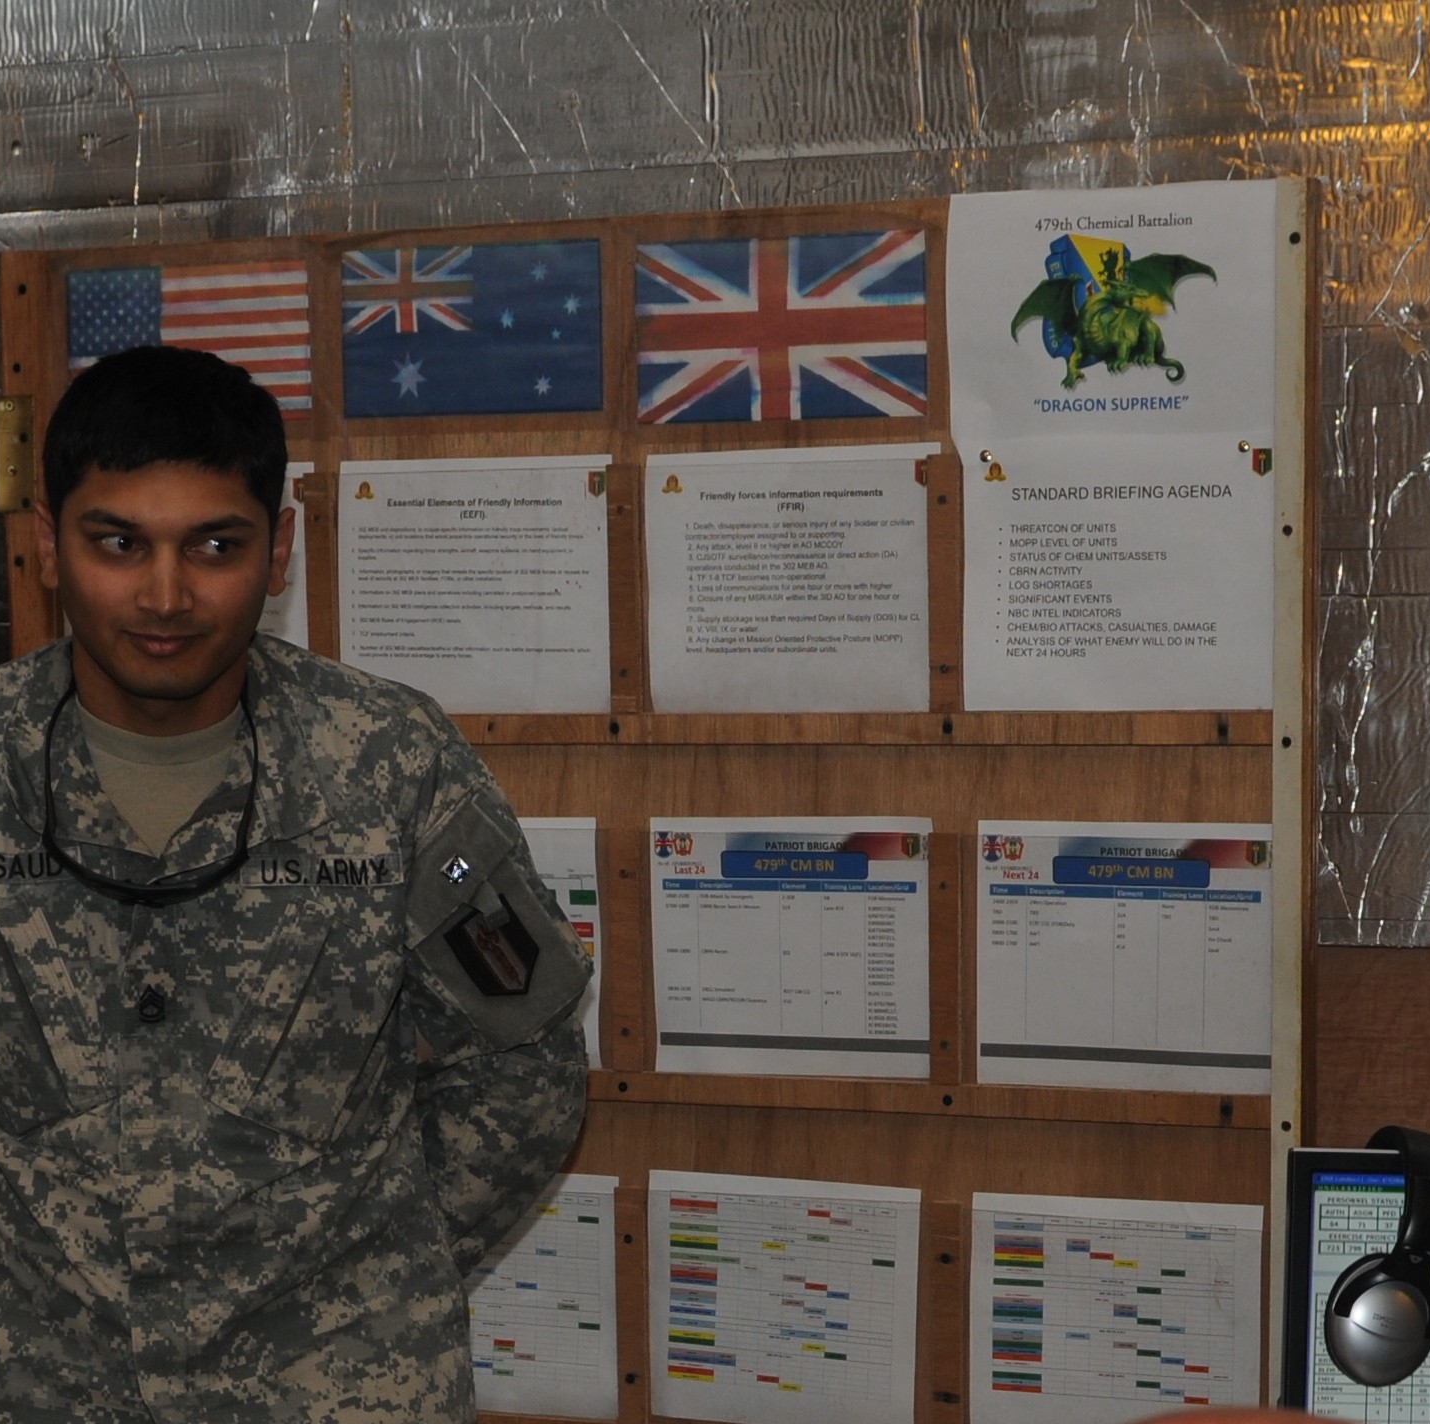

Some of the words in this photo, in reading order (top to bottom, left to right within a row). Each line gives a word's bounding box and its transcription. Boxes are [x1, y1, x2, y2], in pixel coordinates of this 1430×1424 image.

[1034, 218, 1072, 232] 479th
[1077, 215, 1134, 229] Chemical
[1138, 214, 1193, 228] Battalion
[700, 492, 736, 501] Friendly
[823, 488, 883, 499] requirements
[1011, 487, 1089, 501] STANDARD
[1093, 486, 1164, 500] BRIEFING
[1167, 484, 1232, 498] AGENDA
[1010, 523, 1068, 534] THREATCON
[1071, 523, 1084, 534] OF
[1086, 523, 1116, 534] UNITS
[1010, 537, 1038, 548] MOPP
[1039, 537, 1070, 548] LEVEL
[1072, 537, 1086, 548] OF
[1088, 537, 1118, 548] UNITS
[1009, 551, 1046, 562] STATUS
[1049, 551, 1062, 562] OF
[1065, 551, 1093, 562] CHEM
[1095, 551, 1167, 562] UNITS/ASSETS
[1009, 566, 1037, 576] CBRN
[1038, 566, 1082, 576] ACTIVITY
[1008, 580, 1030, 590] LOG
[1033, 580, 1092, 590] SHORTAGES
[1008, 594, 1071, 604] SIGNIFICANT
[1073, 594, 1112, 604] EVENTS
[1008, 608, 1029, 618] NBC
[1032, 608, 1060, 618] INTEL
[1062, 608, 1121, 618] INDICATORS
[1173, 622, 1217, 633] DAMAGE
[1007, 636, 1056, 646] ANALYSIS
[1058, 636, 1072, 646] OF
[1074, 636, 1104, 646] WHAT
[1105, 636, 1140, 646] ENEMY
[1142, 636, 1165, 646] WILL
[1167, 636, 1182, 646] DO
[1185, 636, 1195, 646] IN
[1197, 636, 1217, 646] THE
[1006, 648, 1033, 658] NEXT
[1035, 648, 1047, 658] 24
[1050, 648, 1086, 658] HOURS
[765, 841, 805, 850] PATRIOT
[1100, 847, 1142, 857] PATRIOT
[261, 856, 307, 883] U.S.
[317, 857, 387, 886] ARMY
[674, 865, 693, 874] Last
[694, 866, 705, 874] 24
[791, 860, 812, 872] CM
[815, 860, 834, 872] BN
[1003, 870, 1025, 880] Next
[1027, 870, 1039, 880] 24
[1127, 866, 1149, 878] CM
